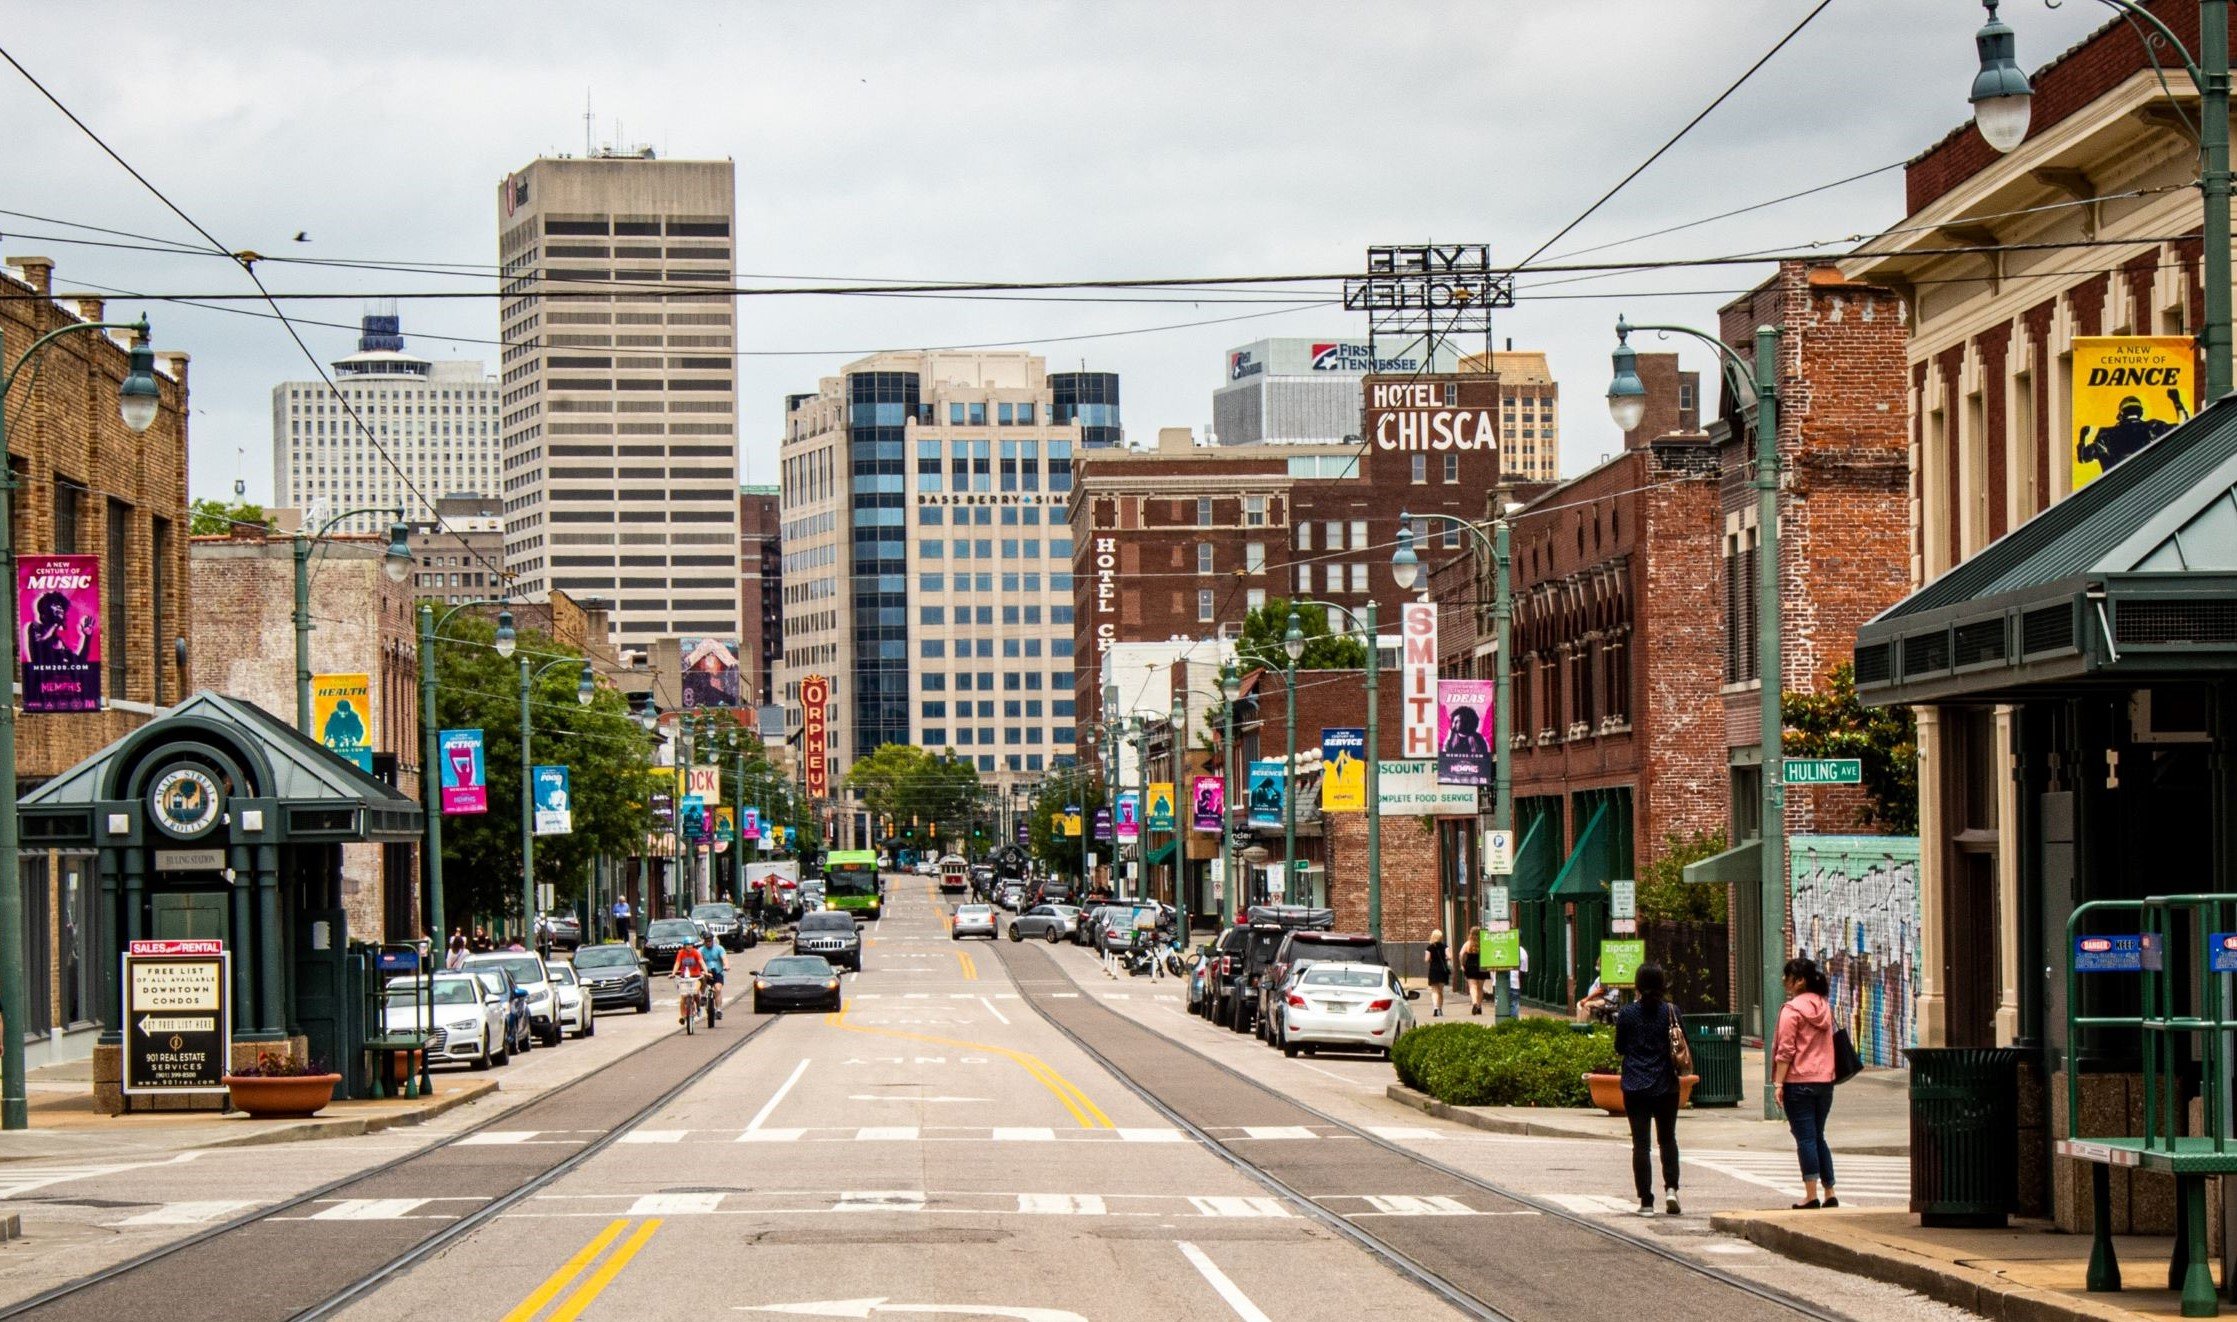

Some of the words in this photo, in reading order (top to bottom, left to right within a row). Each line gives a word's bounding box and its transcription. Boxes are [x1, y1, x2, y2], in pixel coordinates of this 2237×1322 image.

[1339, 344, 1377, 356] FIRST
[1338, 357, 1417, 370] TENNESSEE
[2101, 356, 2149, 364] CENTURY
[2088, 368, 2181, 387] DANCE
[1374, 384, 1442, 407] HOTEL
[1377, 411, 1497, 450] CHISCA
[918, 495, 960, 504] BASS
[967, 495, 1020, 504] BERRY
[1096, 538, 1116, 612] HOTEL
[27, 575, 92, 589] MUSIC
[1408, 607, 1434, 753] SMITH
[41, 682, 82, 694] MEMPHIS
[318, 688, 367, 696] HEALTH
[1446, 693, 1485, 704] IDEAS
[444, 740, 481, 750] ACTION
[807, 686, 823, 798] ORPHEUM
[1324, 738, 1363, 746] SERVICE
[1378, 763, 1426, 774] ISCOUNT
[1789, 763, 1838, 780] HULING
[1841, 766, 1857, 776] AVE
[156, 773, 178, 796] MAIN
[185, 770, 215, 795] STREET
[1378, 794, 1412, 803] OMPLETE
[1415, 793, 1437, 802] FOOD
[1441, 793, 1474, 802] SERVICE
[163, 817, 211, 832] TROLLEY
[133, 943, 166, 953] SALES
[181, 942, 220, 953] RENTAL
[1605, 944, 1640, 953] zipcars
[143, 1020, 156, 1029] GET
[159, 1020, 174, 1029] FREE
[178, 1020, 192, 1028] LIST
[196, 1020, 212, 1028] HERE
[146, 1053, 158, 1062] 901
[160, 1053, 178, 1062] REAL
[180, 1052, 206, 1061] ESTATE
[151, 1063, 202, 1071] SERVICES
